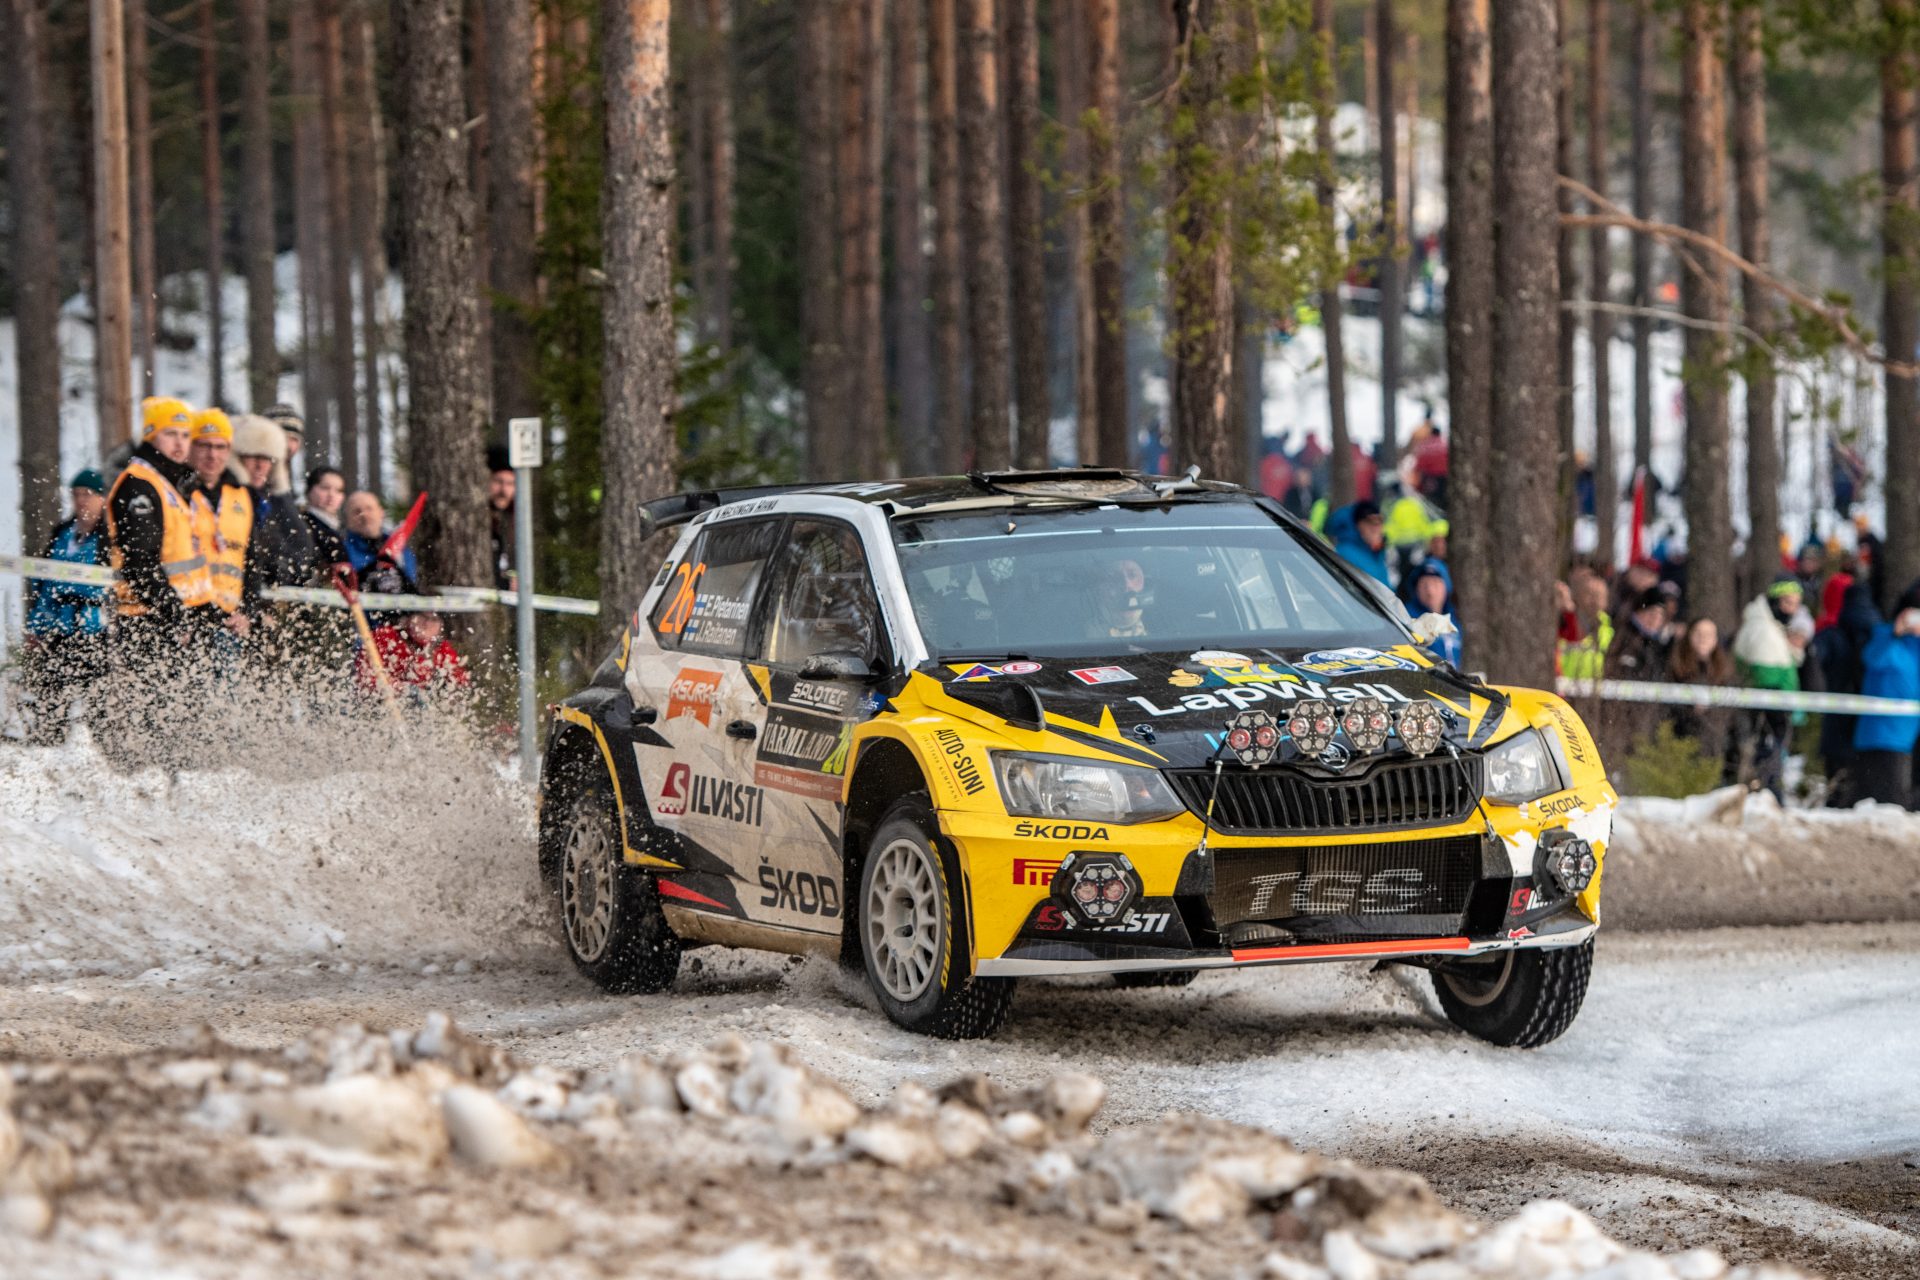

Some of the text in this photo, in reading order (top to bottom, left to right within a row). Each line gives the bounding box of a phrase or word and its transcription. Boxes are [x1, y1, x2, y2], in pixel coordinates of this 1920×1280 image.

[658, 562, 706, 635] 26
[1127, 680, 1412, 717] LapWall
[933, 728, 986, 796] AUTO-SUNI
[1013, 820, 1110, 841] ŠKODA
[758, 855, 844, 919] ŠKOD
